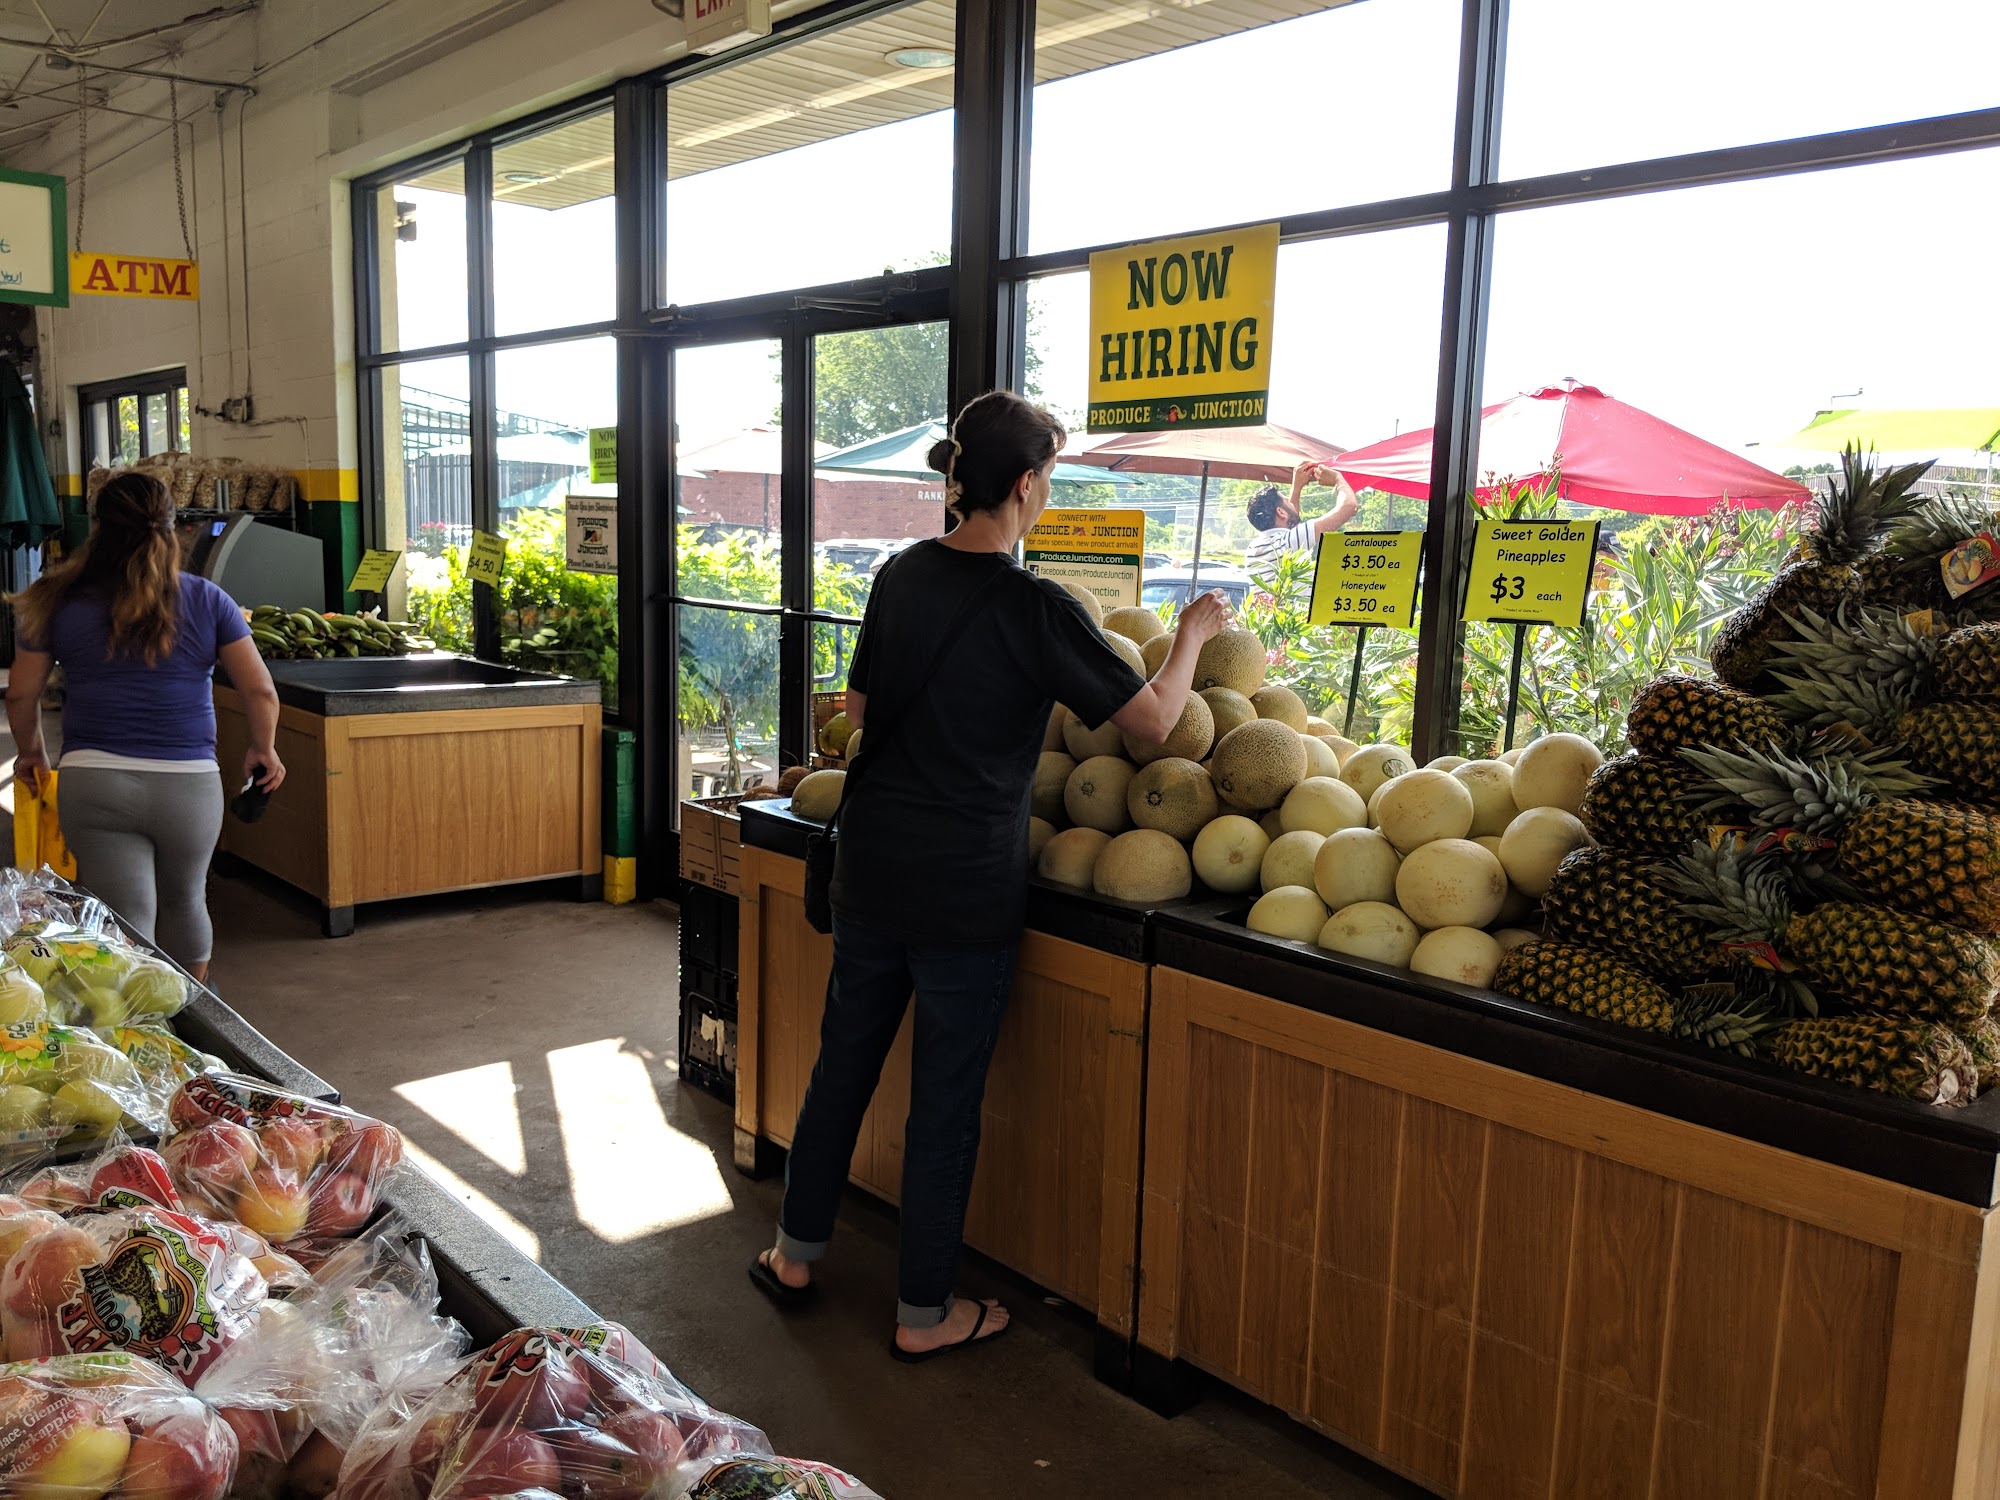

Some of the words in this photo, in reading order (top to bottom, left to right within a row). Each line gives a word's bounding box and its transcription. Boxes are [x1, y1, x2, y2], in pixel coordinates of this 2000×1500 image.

[82, 258, 192, 296] ATM
[1127, 245, 1234, 310] NOW
[1100, 317, 1258, 382] HIRING
[1090, 405, 1151, 426] PRODUCE
[1191, 397, 1265, 421] JUNCTION
[598, 431, 617, 443] NOW
[594, 447, 617, 460] HIRIN
[577, 517, 608, 528] PRODUCE
[1057, 513, 1087, 522] CONNECT
[1091, 527, 1139, 537] JUNCTION
[1491, 528, 1533, 541] Sweet
[1539, 526, 1585, 541] Golden
[577, 545, 609, 555] JUNCTION
[1037, 538, 1050, 548] daily
[1091, 541, 1114, 549] product
[1345, 538, 1398, 549] Cantaloupes
[468, 555, 494, 574] $4.50
[1040, 552, 1123, 564] ProduceJunction.com
[1341, 554, 1386, 571] $3.50
[1388, 561, 1400, 569] ea
[1497, 549, 1566, 565] Pineapples
[1041, 567, 1134, 580] facebook.com/ProduceJunction
[1341, 581, 1386, 592] Honeydew
[1490, 573, 1525, 604] $3
[1537, 591, 1562, 601] each
[1333, 596, 1377, 613] $3.50
[1383, 605, 1395, 613] ea
[80, 1263, 133, 1347] COUNTRY
[5, 1390, 49, 1425] Apple
[0, 1428, 27, 1450] lace,
[22, 1395, 76, 1428] Glenmo
[0, 1405, 84, 1467] wyorkapples
[0, 1451, 40, 1482] oduce
[43, 1436, 60, 1454] of
